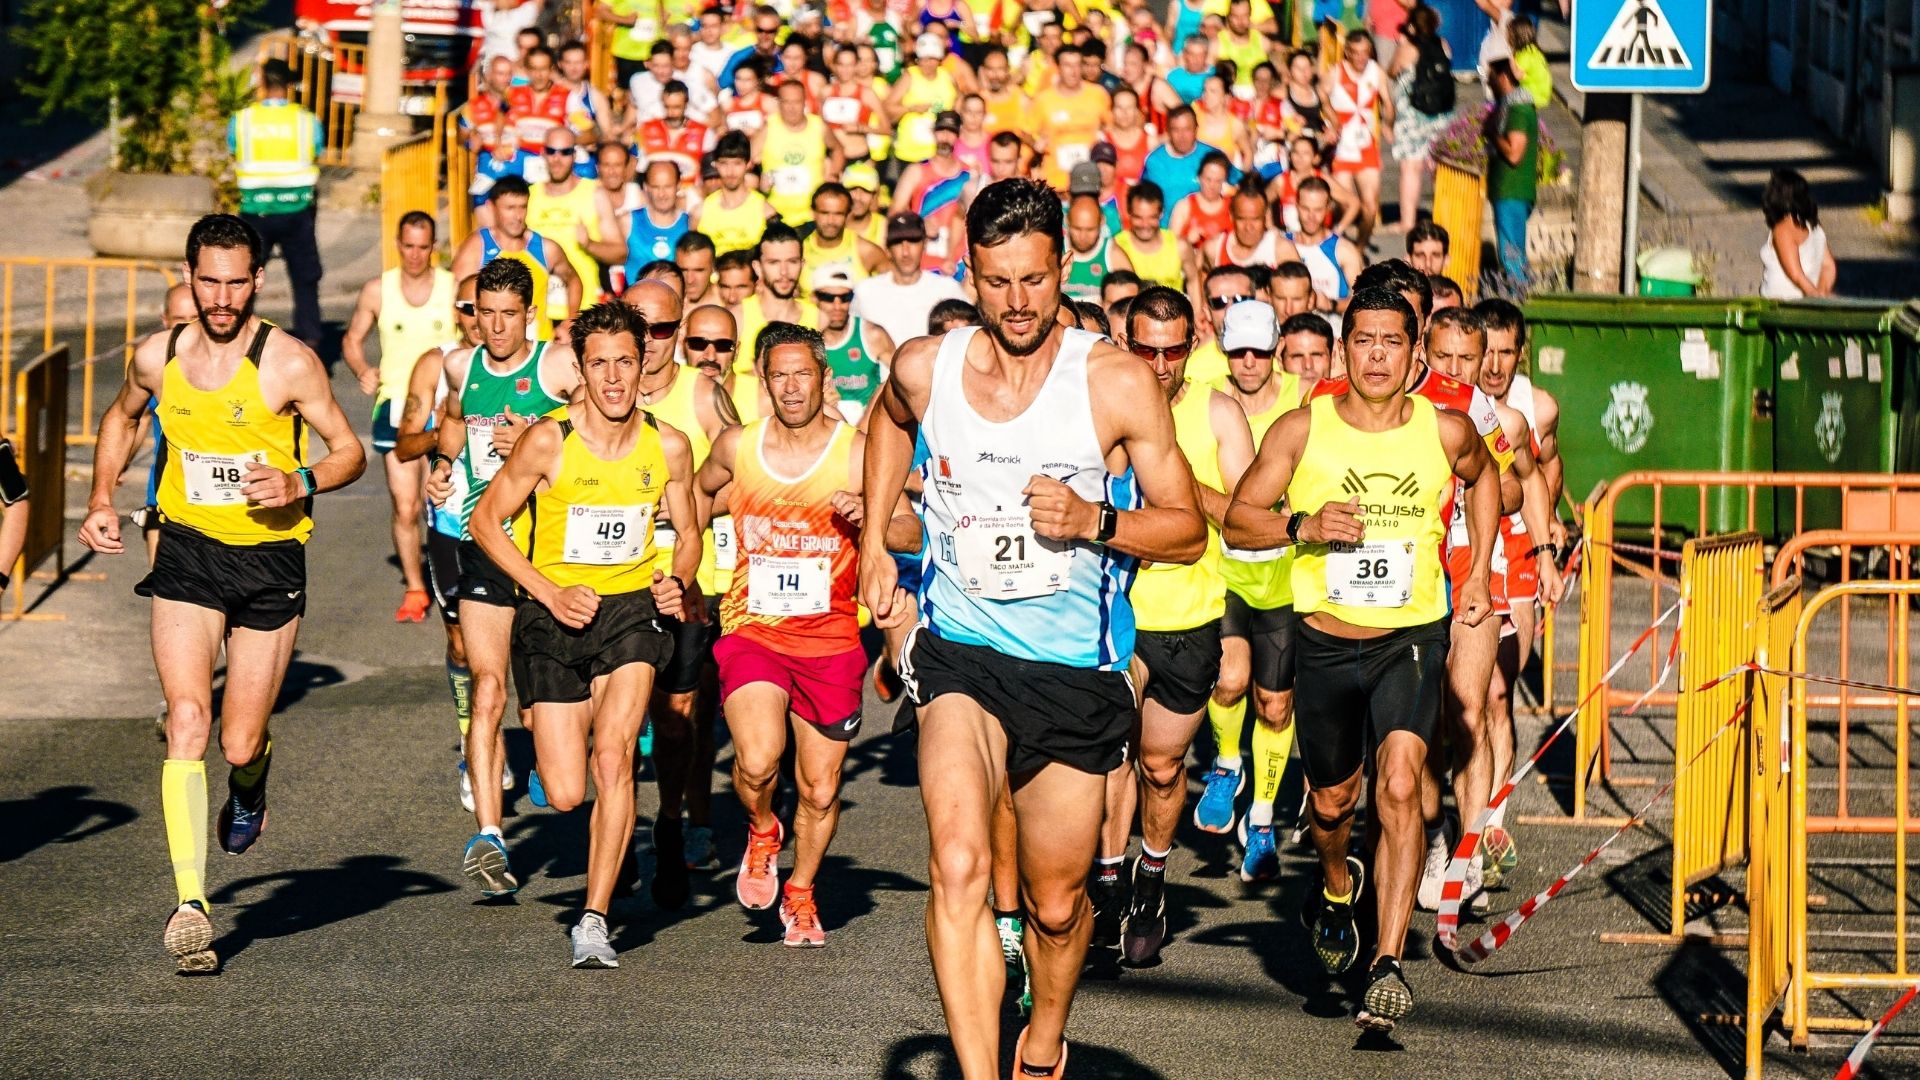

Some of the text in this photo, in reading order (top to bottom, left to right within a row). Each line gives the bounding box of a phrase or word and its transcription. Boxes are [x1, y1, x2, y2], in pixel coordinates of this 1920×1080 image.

[212, 466, 241, 483] 48
[571, 506, 590, 517] 10ª
[1358, 503, 1425, 518] nquista
[596, 521, 626, 540] 49
[772, 532, 841, 552] VALE GRANDE
[995, 535, 1025, 562] 21
[1008, 562, 1035, 570] MATIAS
[1356, 558, 1388, 579] 36
[777, 573, 799, 592] 14
